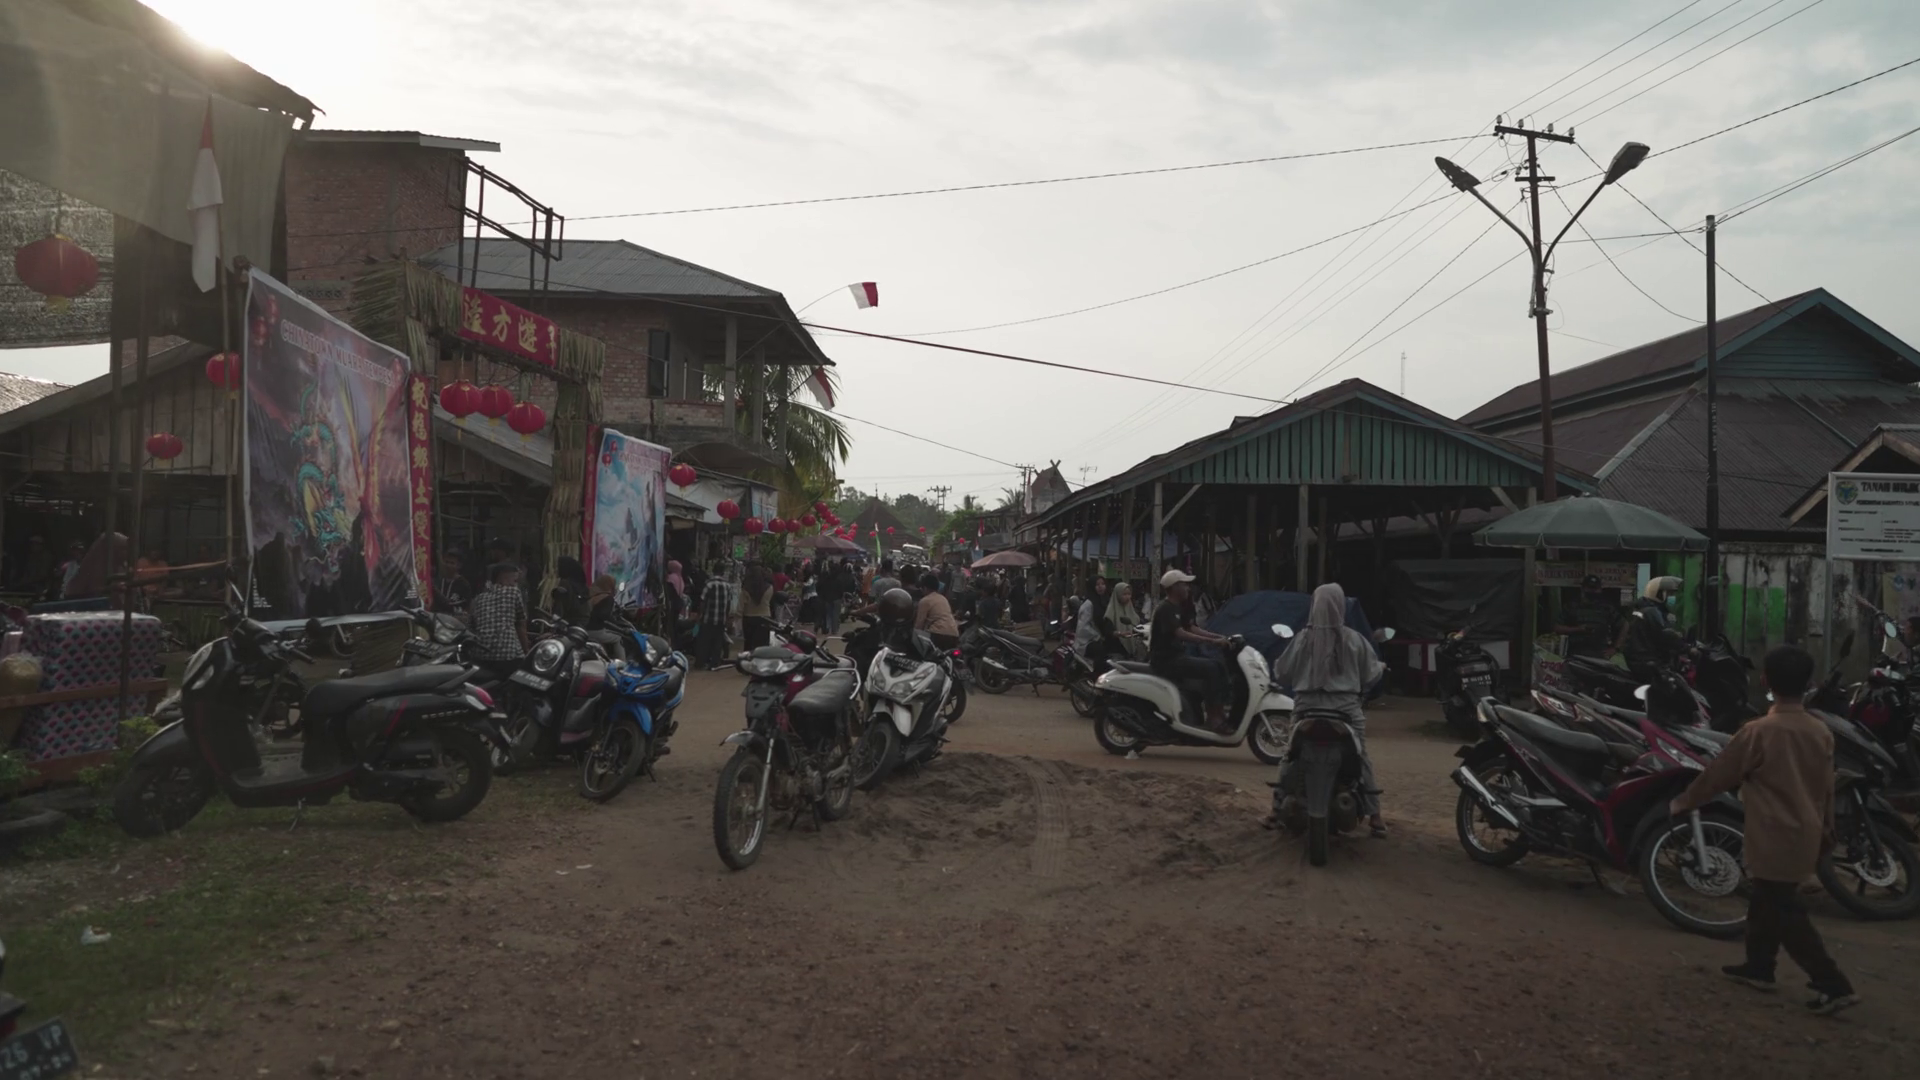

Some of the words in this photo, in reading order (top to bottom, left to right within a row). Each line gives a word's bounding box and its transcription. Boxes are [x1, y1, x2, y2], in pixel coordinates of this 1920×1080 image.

[280, 318, 333, 360] CHINATOWN
[1860, 481, 1891, 493] TANAH
[1892, 482, 1920, 495] MILIK
